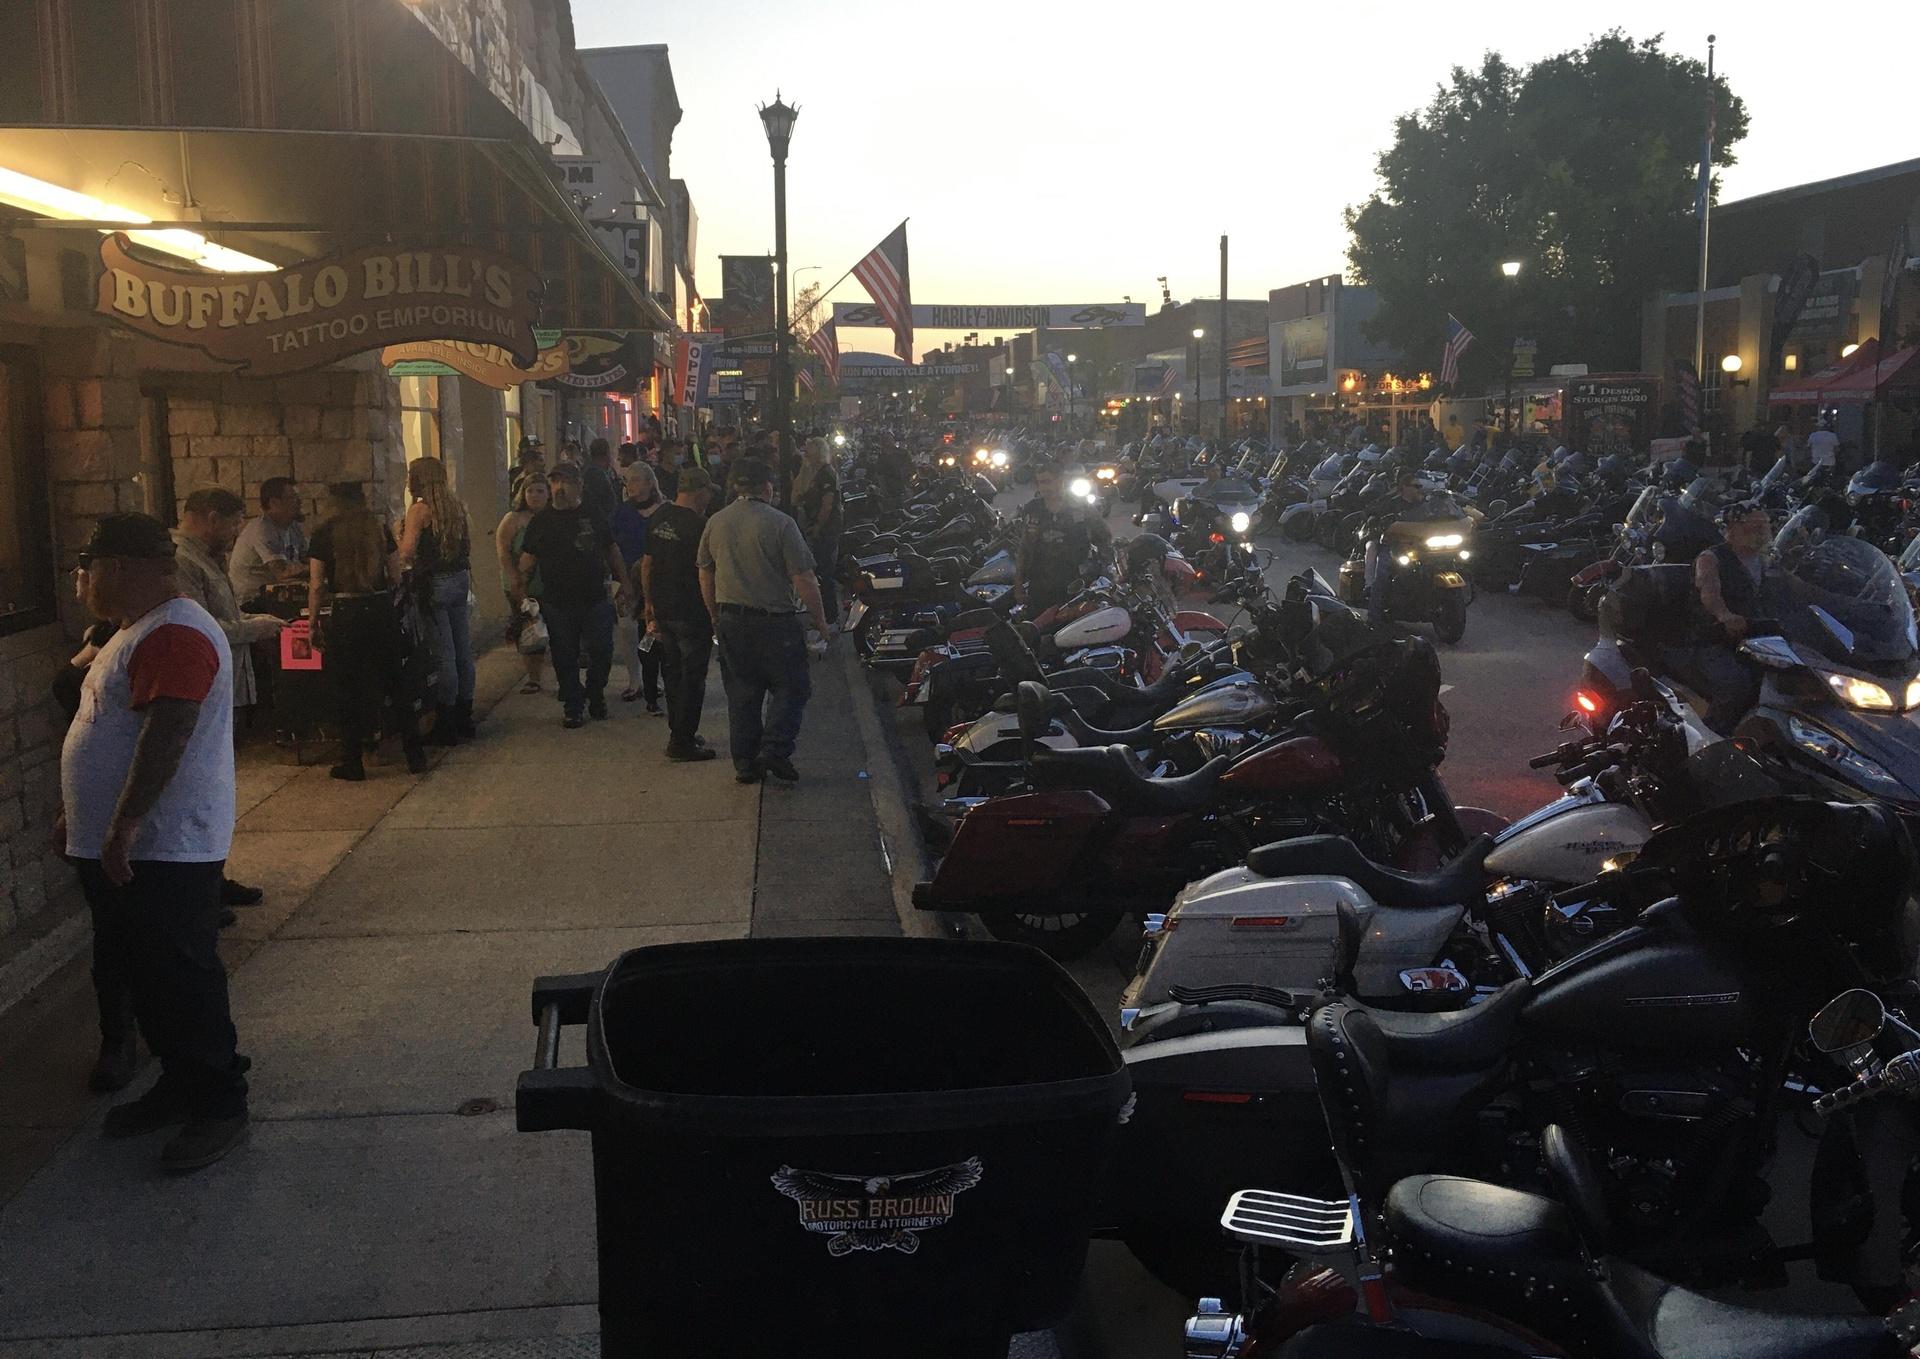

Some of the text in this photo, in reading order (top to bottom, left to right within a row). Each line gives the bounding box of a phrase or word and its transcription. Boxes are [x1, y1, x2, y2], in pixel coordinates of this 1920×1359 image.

[112, 252, 513, 329] BUFFALO BILL'S
[932, 306, 1051, 327] HARLEY-DAVIDSON
[266, 314, 368, 354] TATTOO
[376, 305, 516, 339] EMPORIUM
[398, 343, 452, 360] AVAILABLE
[456, 356, 488, 377] INSIDE
[586, 366, 625, 386] STATES
[684, 346, 700, 403] OPEN
[862, 365, 925, 377] MOTORCYCLE
[1600, 387, 1641, 395] DESIGN
[1620, 394, 1649, 402] 2020
[803, 1195, 951, 1220] RUSS BROWN
[808, 1216, 943, 1231] MOTORCYCLE ATTORNEYS
